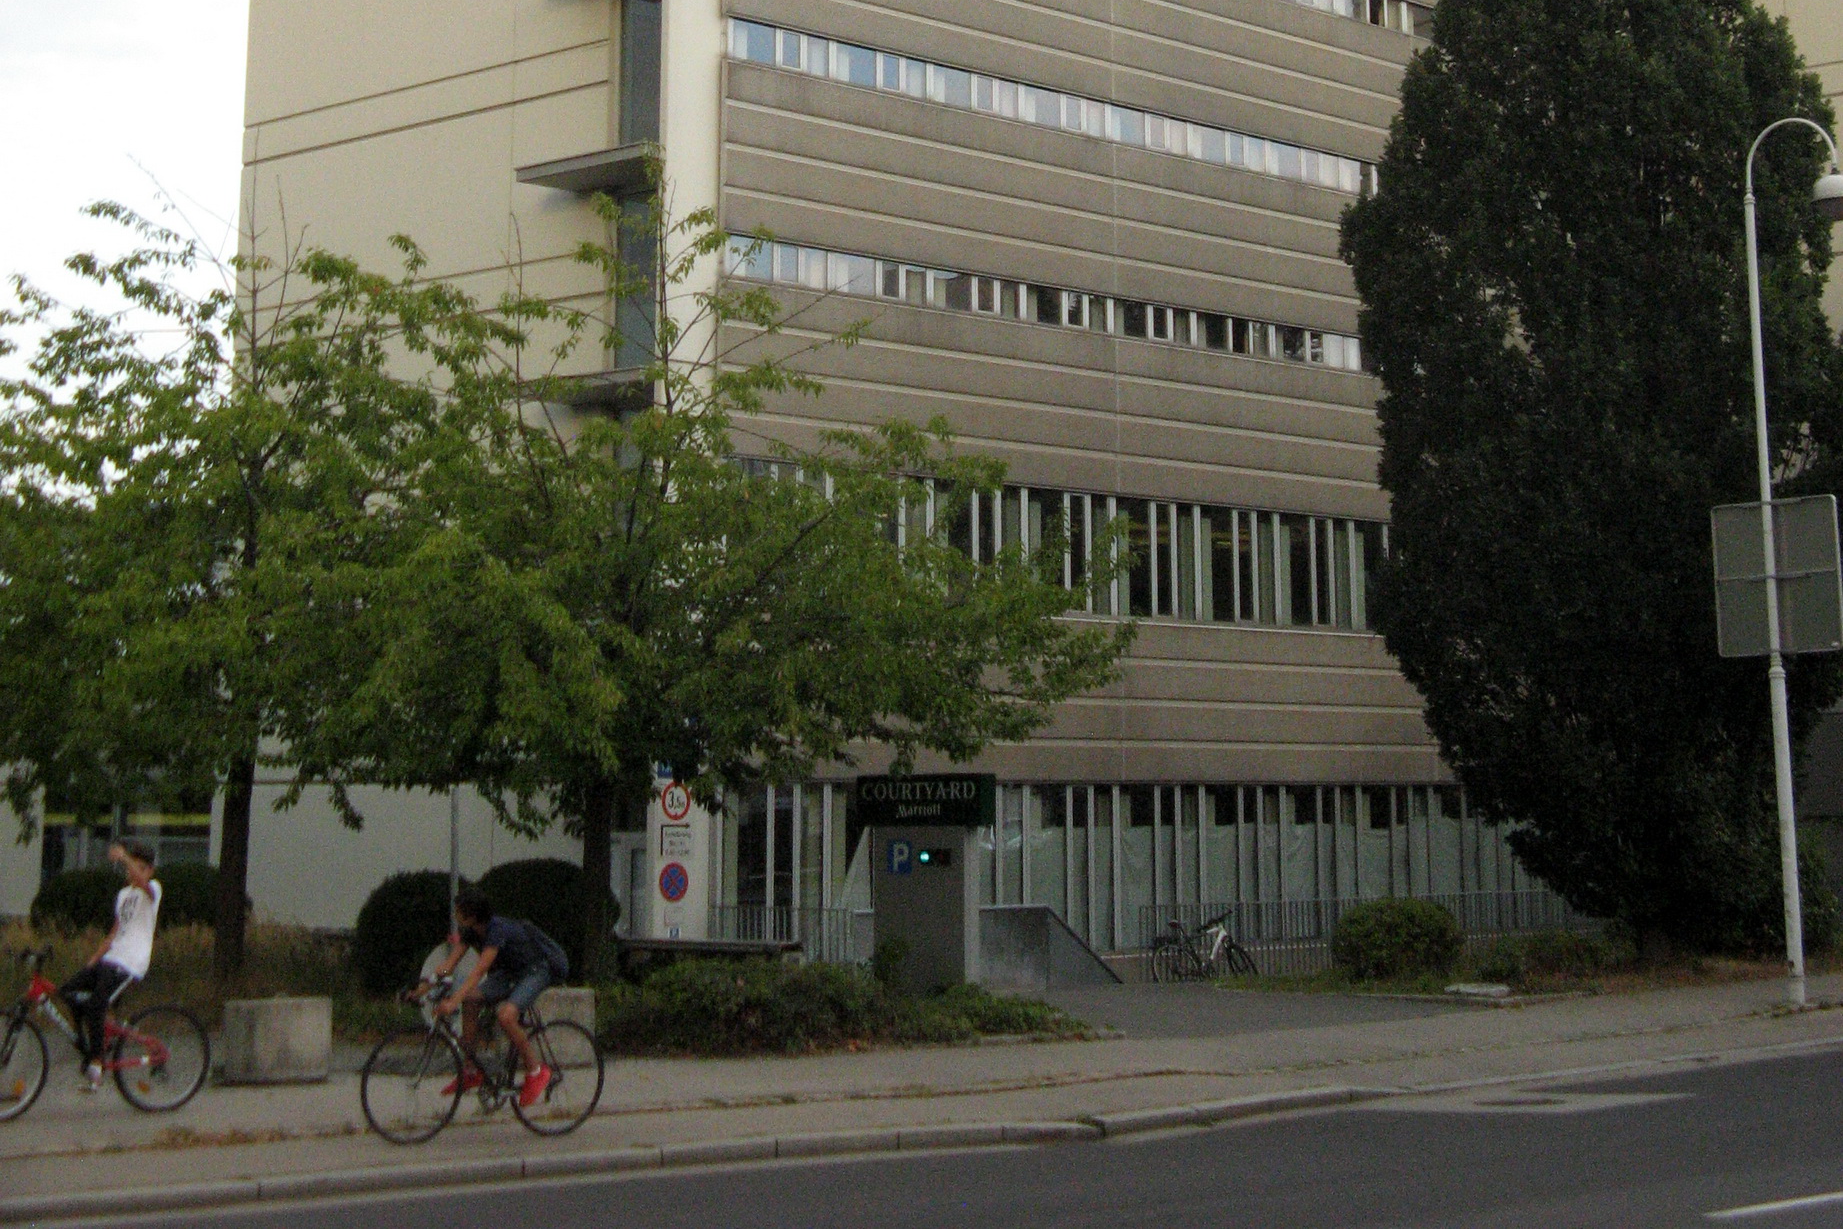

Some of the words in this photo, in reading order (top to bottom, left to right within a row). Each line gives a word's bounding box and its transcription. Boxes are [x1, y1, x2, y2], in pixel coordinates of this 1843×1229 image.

[862, 780, 976, 801] COURTYARD
[895, 803, 941, 819] Marriott
[893, 842, 909, 871] P
